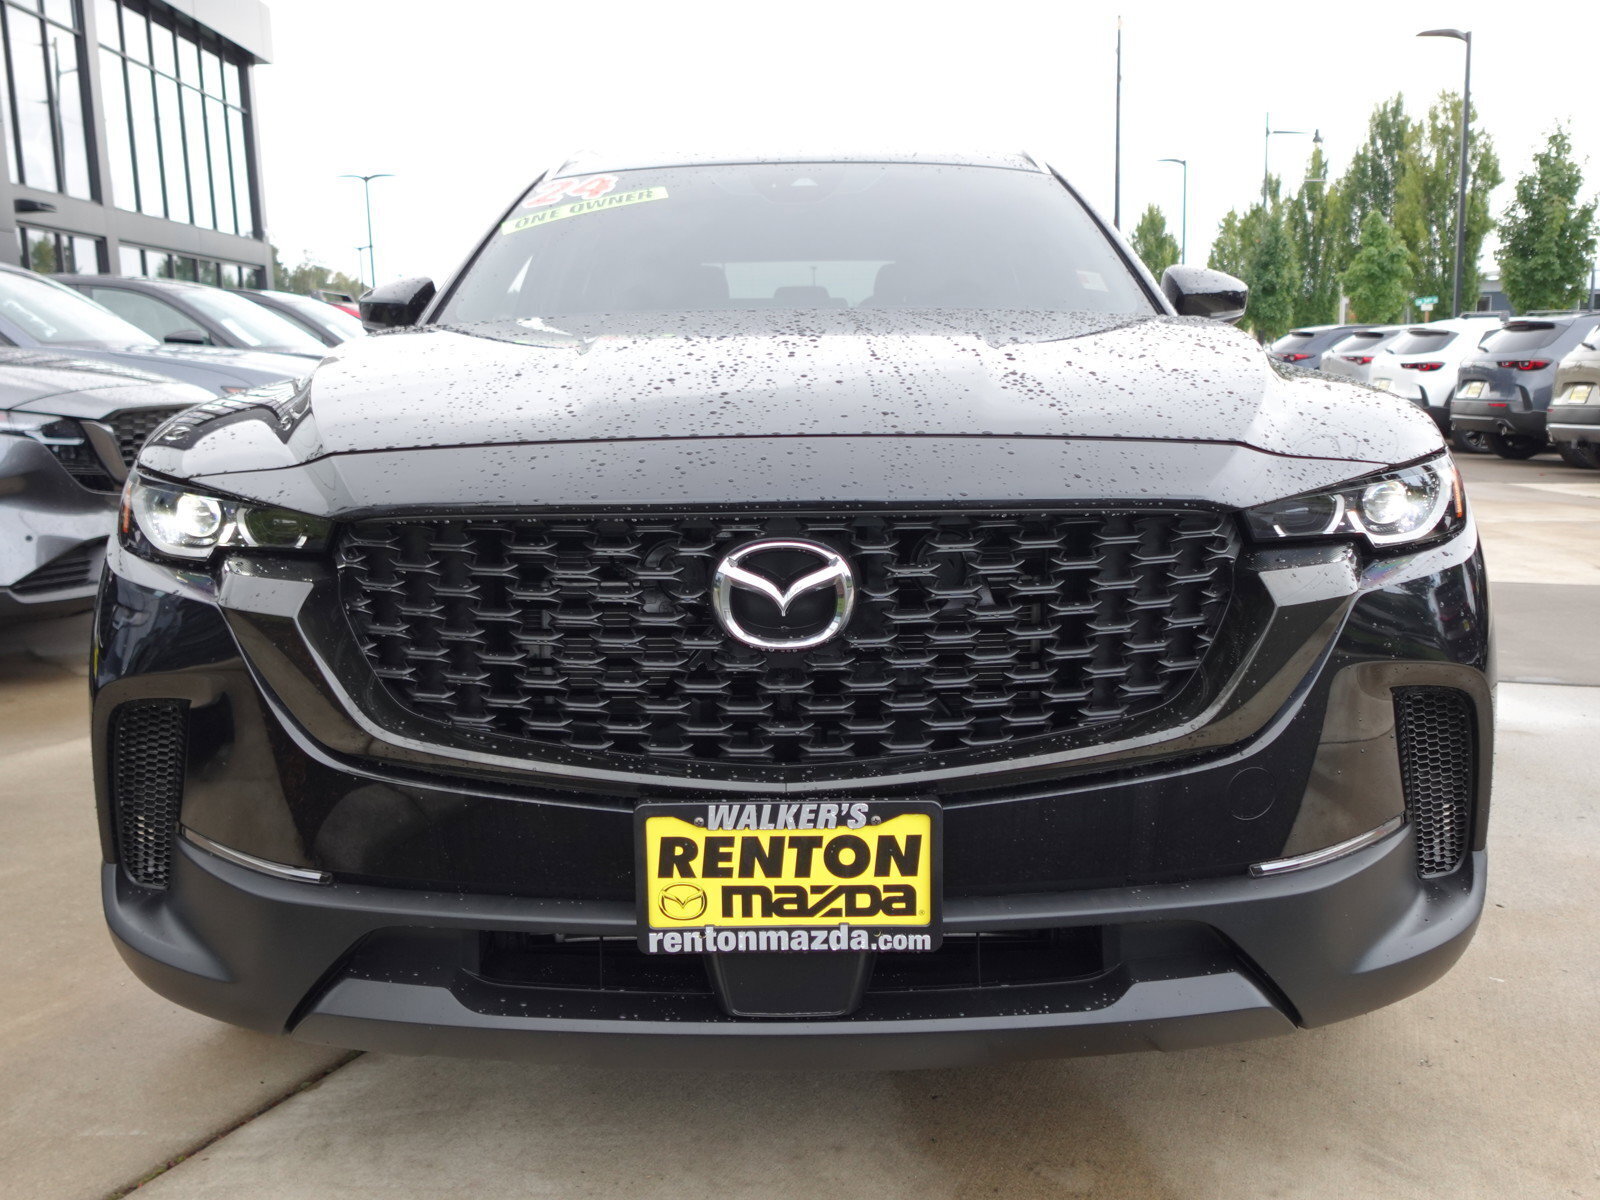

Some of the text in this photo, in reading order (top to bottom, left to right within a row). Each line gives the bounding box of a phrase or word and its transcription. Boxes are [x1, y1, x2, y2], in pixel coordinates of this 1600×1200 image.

[524, 176, 616, 207] 24
[514, 190, 653, 229] ONE OWNER
[707, 803, 869, 830] WALKER'S
[657, 834, 922, 878] RENTON
[648, 924, 931, 952] rentonmazda.com
